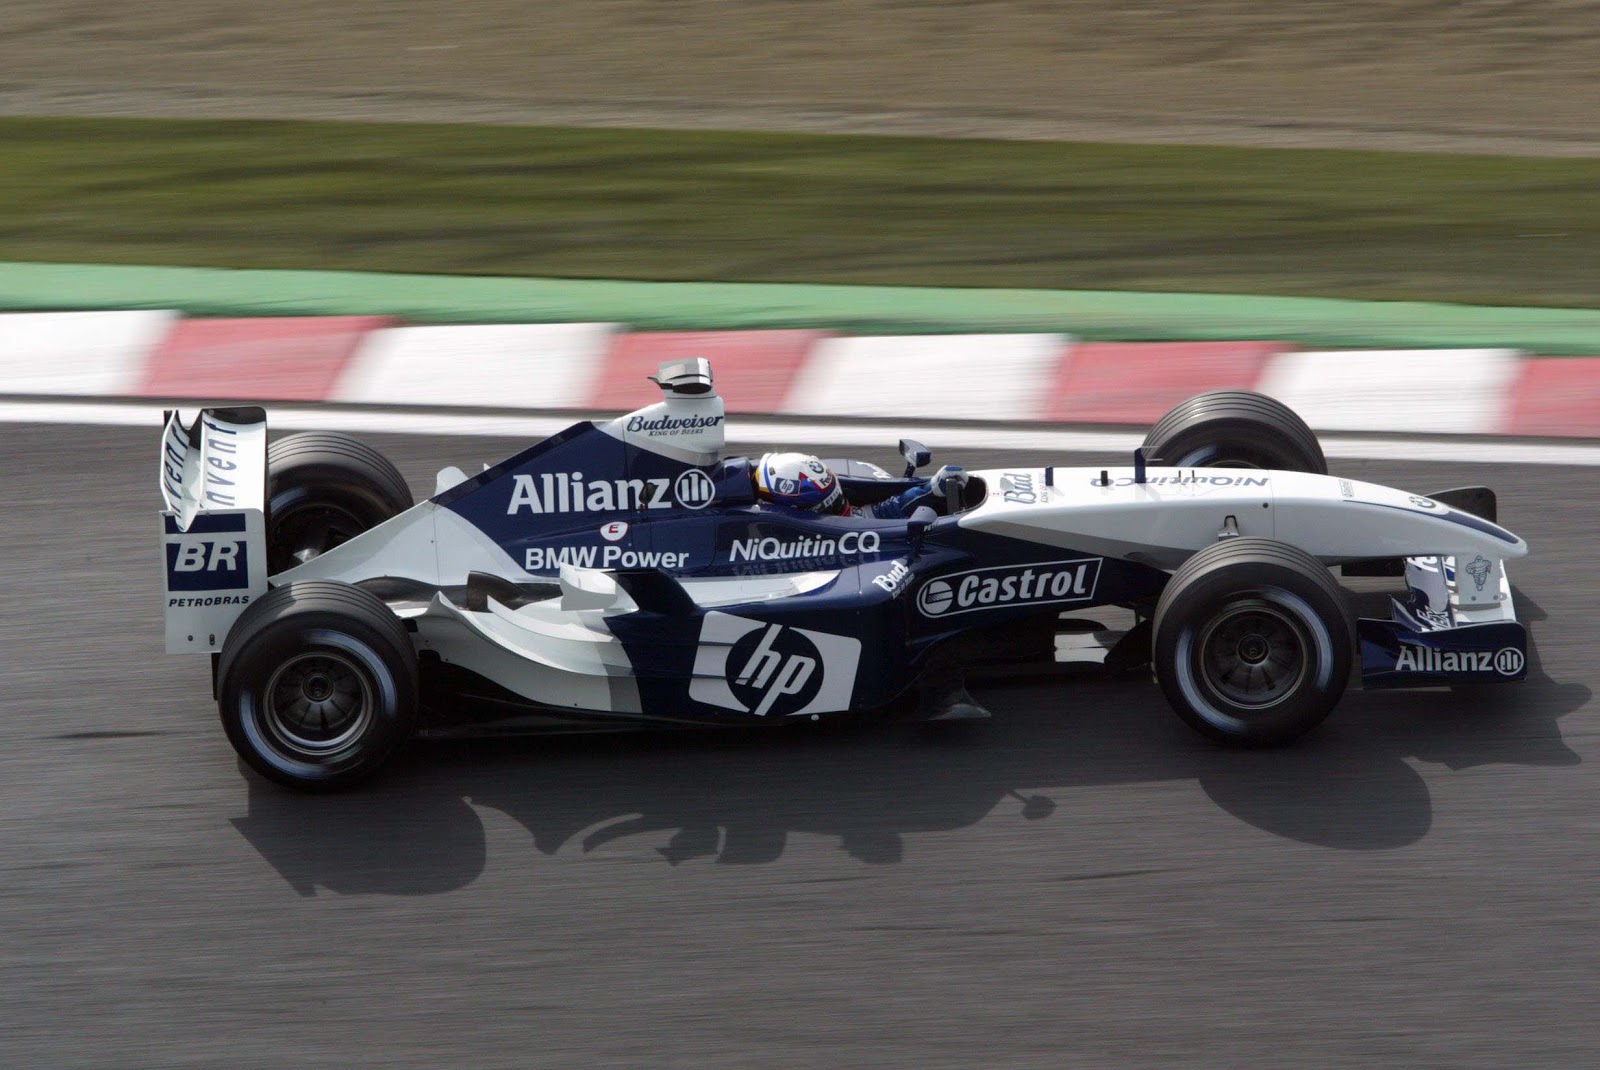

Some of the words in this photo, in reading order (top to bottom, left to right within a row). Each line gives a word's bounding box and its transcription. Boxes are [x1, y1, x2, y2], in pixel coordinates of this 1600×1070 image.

[626, 414, 723, 432] Budweiser
[506, 471, 672, 515] Allianz
[608, 524, 619, 534] E
[173, 541, 239, 572] BR
[525, 546, 597, 570] BMW
[602, 544, 690, 568] Power
[871, 560, 909, 592] Bud
[957, 564, 1087, 608] Castrol
[168, 595, 250, 608] PETROBRAS
[734, 623, 817, 717] hp
[1395, 645, 1493, 673] Allianz
